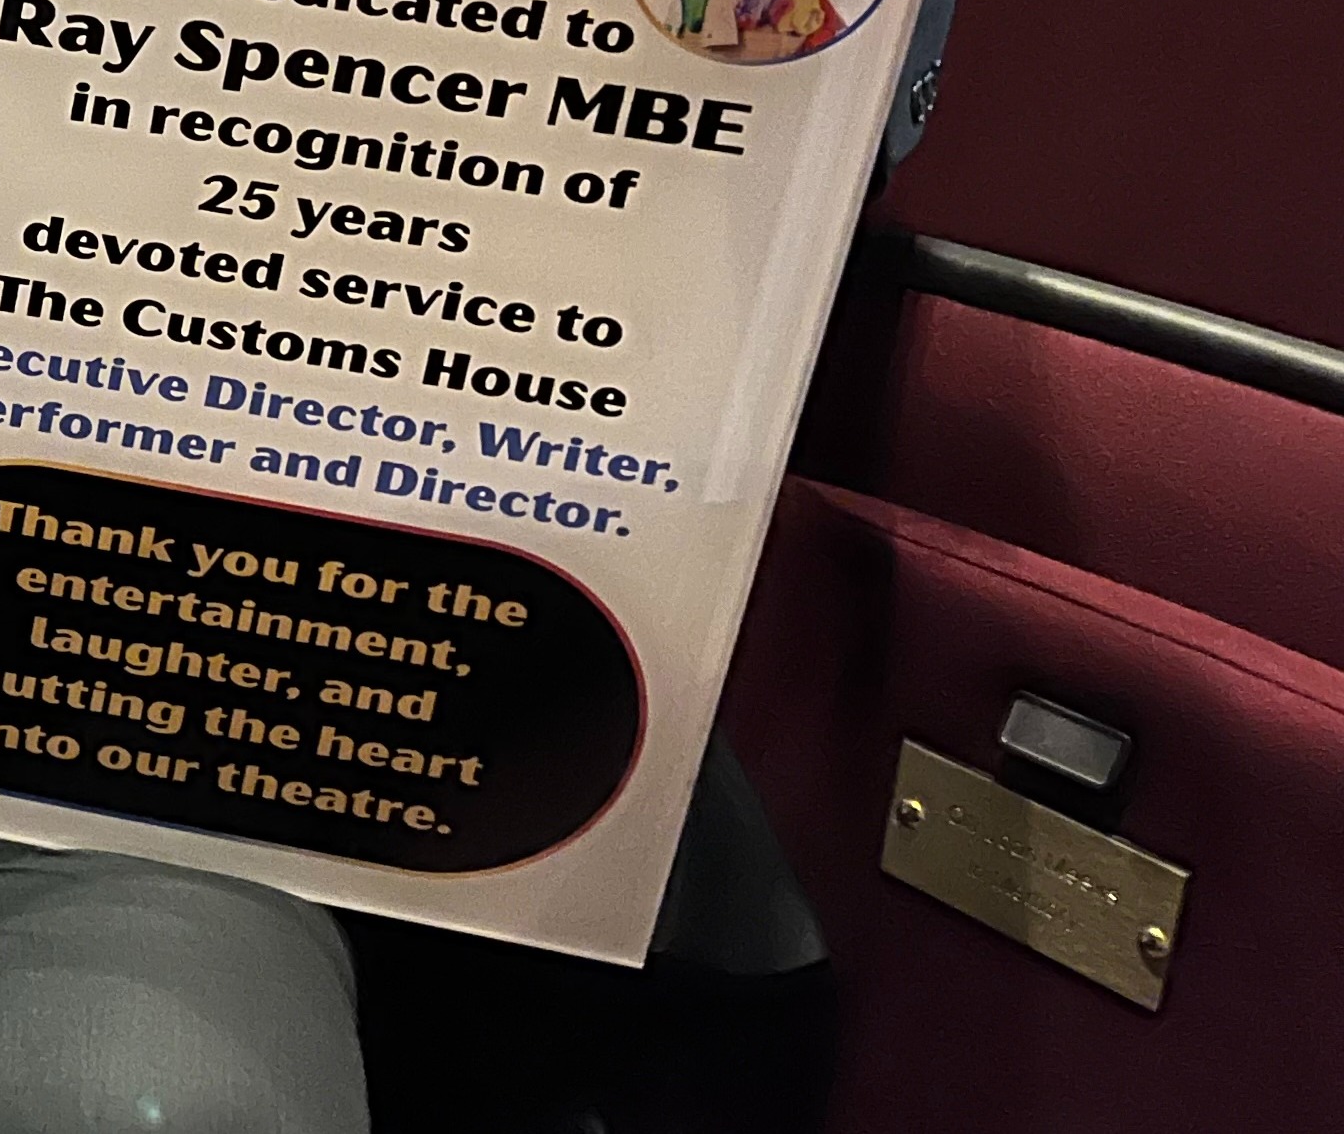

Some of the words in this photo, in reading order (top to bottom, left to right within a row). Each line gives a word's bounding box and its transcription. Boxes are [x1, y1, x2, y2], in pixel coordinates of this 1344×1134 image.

[566, 9, 635, 54] to
[173, 20, 528, 118] Spencer
[546, 76, 753, 156] MBE
[70, 82, 131, 130] in
[149, 105, 545, 196] recognition
[563, 169, 641, 209] of
[197, 174, 280, 220] 25
[290, 197, 471, 253] years
[23, 216, 285, 291] devoted
[298, 268, 536, 333] service
[556, 305, 623, 348] to
[122, 299, 402, 379] Customs
[422, 348, 627, 418] House
[204, 375, 456, 454] Director,
[479, 422, 679, 493] Writer,
[249, 447, 362, 488] and
[374, 460, 630, 537] Director.
[16, 567, 470, 677] entertainment,
[187, 543, 299, 585] you
[318, 561, 409, 604] for
[427, 583, 527, 627] the
[30, 616, 300, 699] laughter,
[319, 680, 437, 722] and
[97, 745, 199, 782] our
[217, 764, 450, 834] theatre.
[204, 707, 300, 749] the
[317, 726, 482, 785] heart
